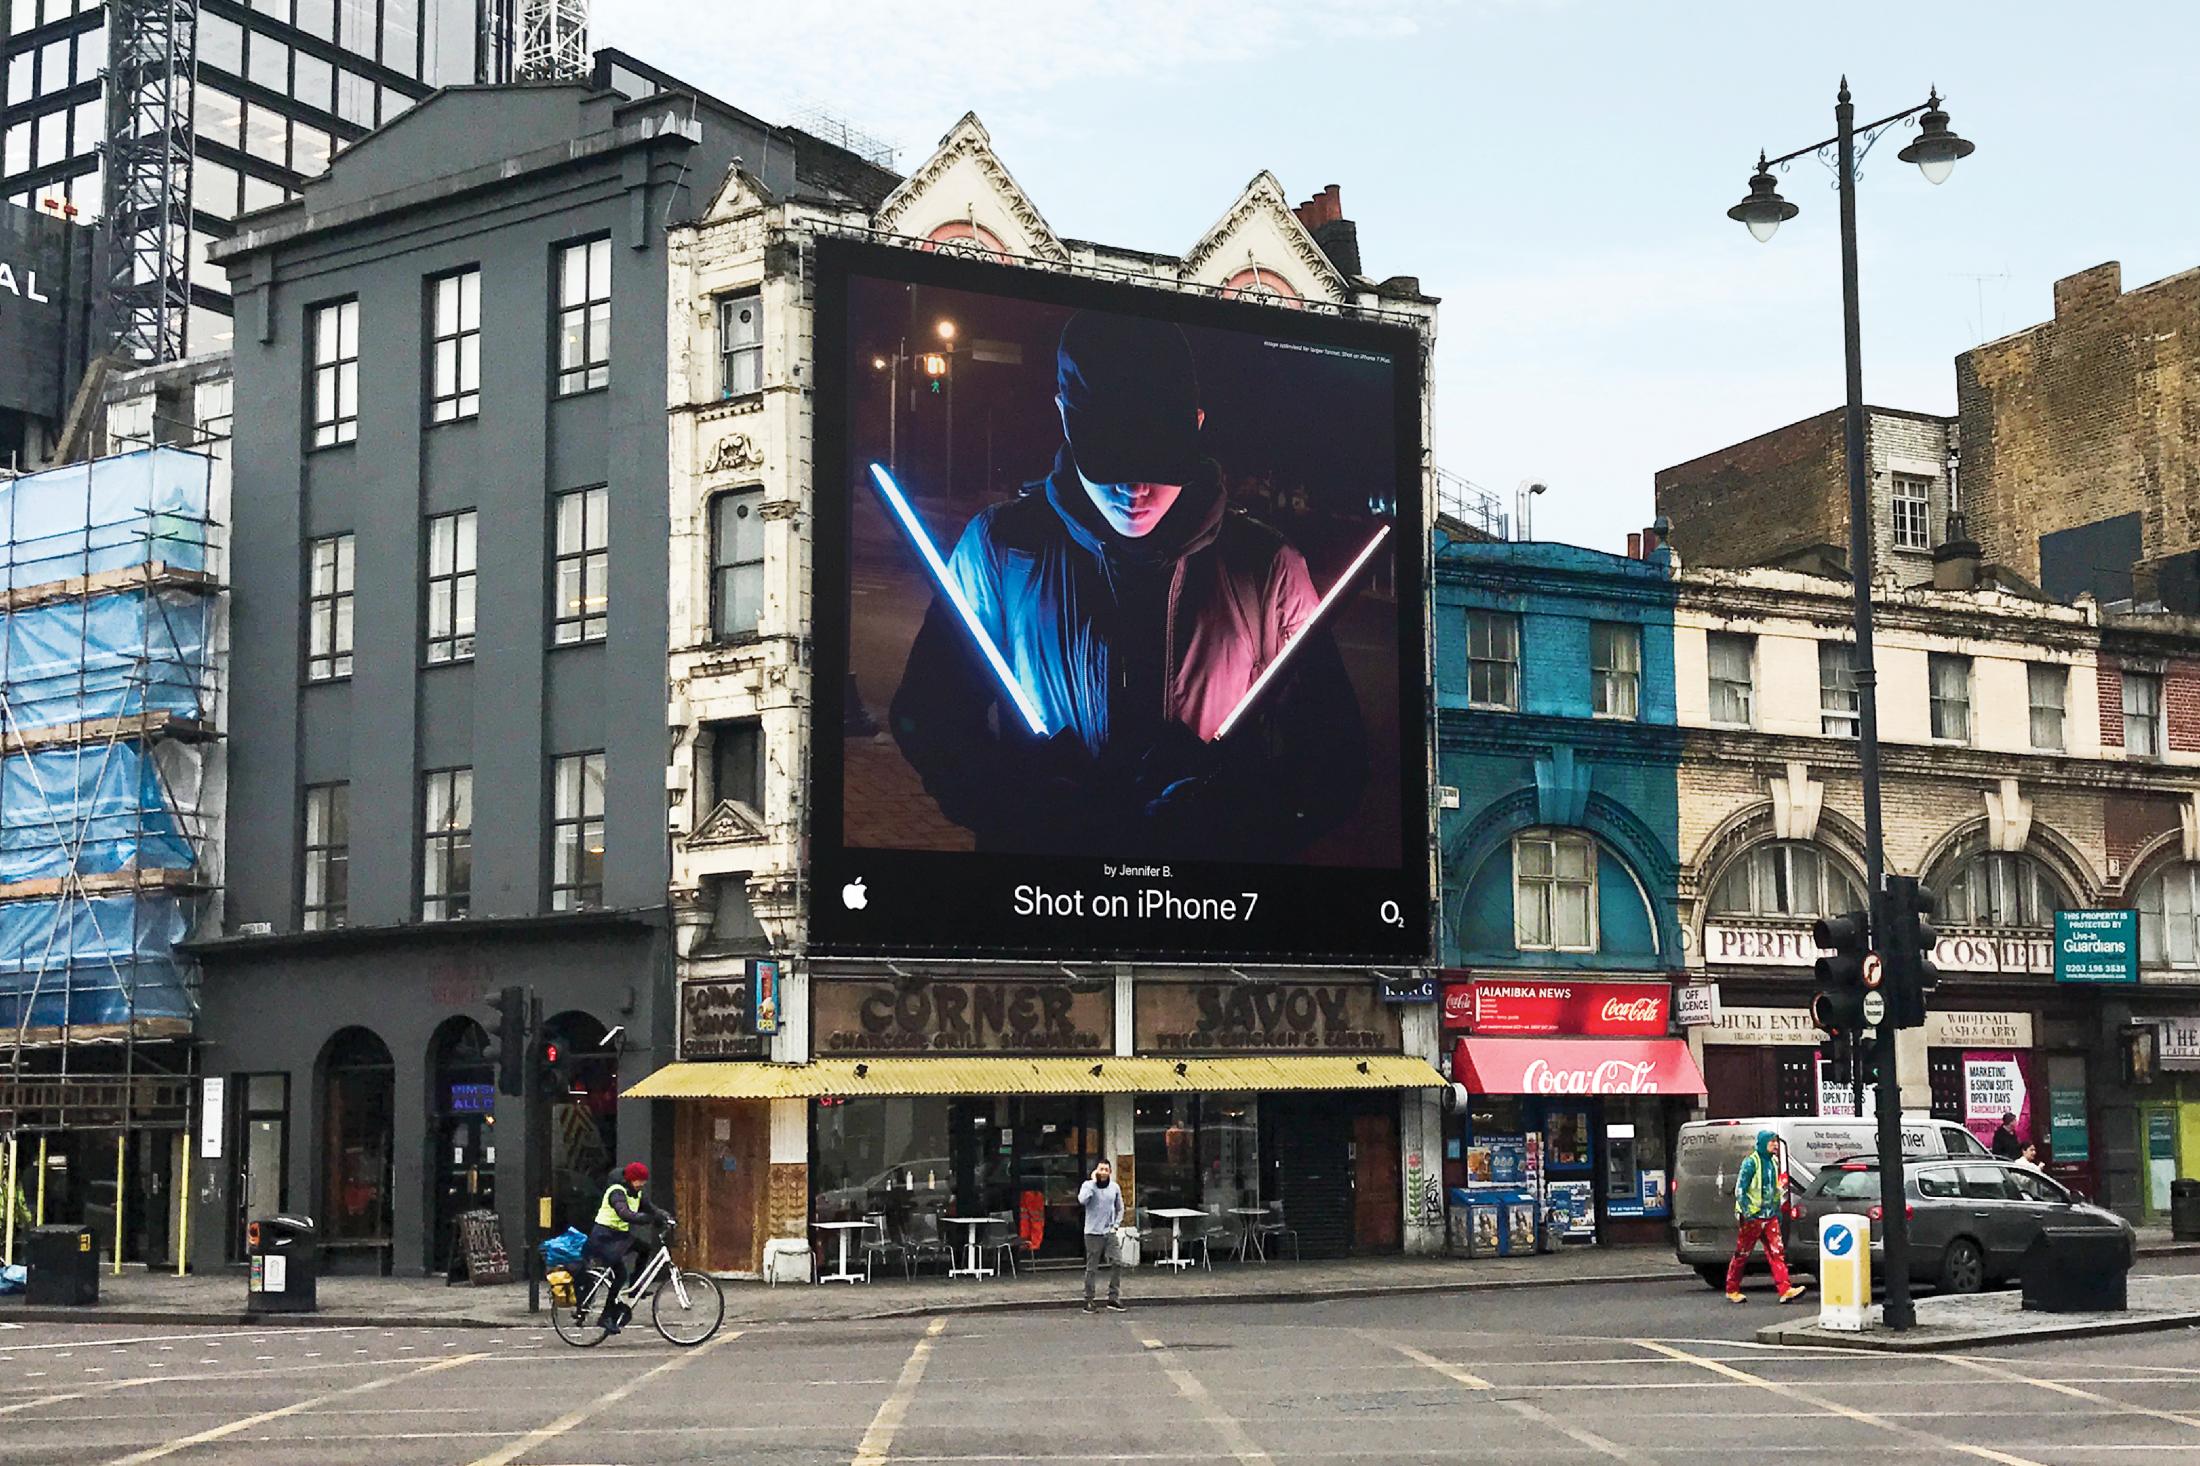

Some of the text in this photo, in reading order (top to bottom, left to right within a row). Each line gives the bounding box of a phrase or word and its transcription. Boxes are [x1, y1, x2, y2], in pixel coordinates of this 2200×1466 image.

[1104, 864, 1173, 878] by Jennifer B.
[1013, 885, 1258, 921] Shot on iPhone 7
[2081, 912, 2119, 920] PROPERTY
[1718, 930, 1835, 960] PERFU
[2063, 939, 2126, 953] Guardians
[1539, 988, 1572, 999] NEWS
[1685, 990, 1698, 999] OFF
[860, 983, 1077, 1034] CORNER
[1196, 984, 1348, 1032] SAVOY
[1601, 997, 1662, 1022] Coca-Cola
[1678, 1000, 1709, 1011] LICENCE
[1523, 1059, 1657, 1095] Coca-Cola
[1969, 1066, 2006, 1078] MARKETING
[1976, 1080, 1995, 1091] SHOW
[1995, 1081, 2014, 1091] SUITE
[1823, 1093, 1841, 1104] OPEN
[1842, 1093, 1847, 1103] 7
[1970, 1093, 2011, 1104] OPEN 7 DAYS
